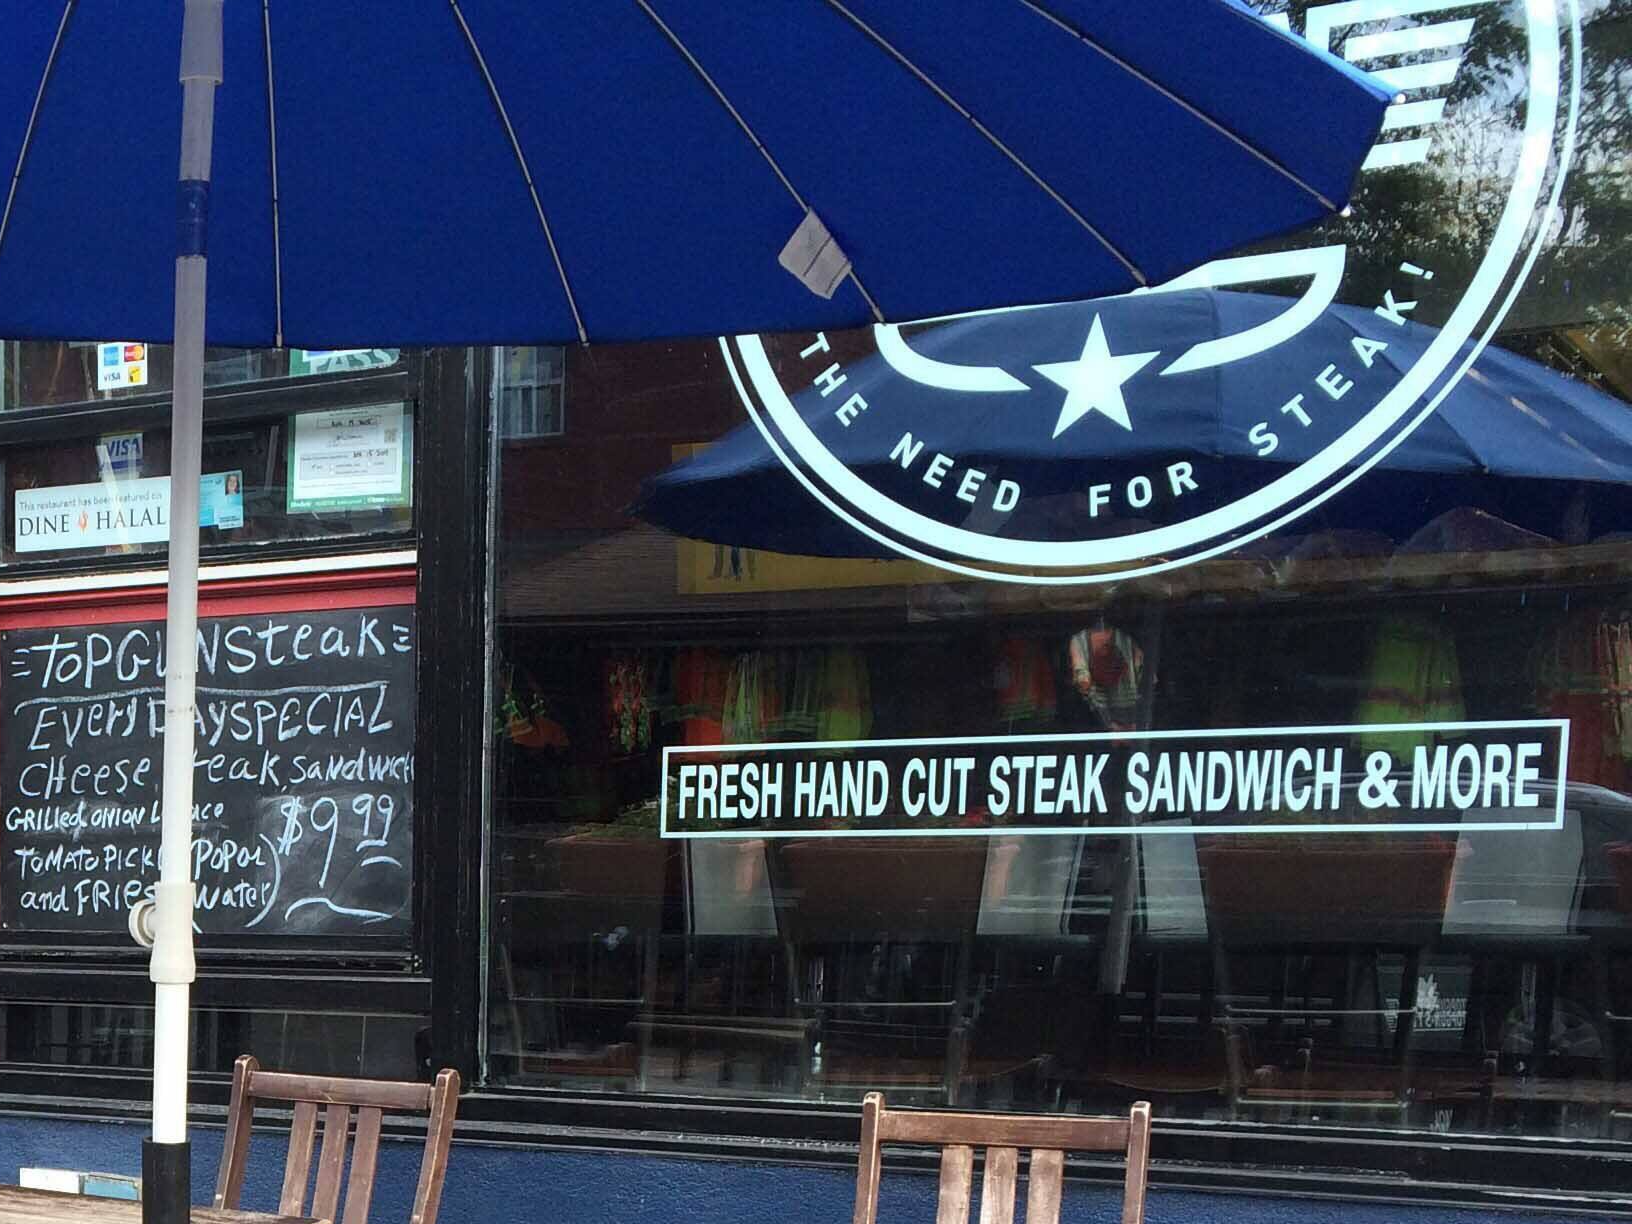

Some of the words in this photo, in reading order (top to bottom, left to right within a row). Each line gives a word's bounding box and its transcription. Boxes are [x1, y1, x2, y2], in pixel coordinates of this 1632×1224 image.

[103, 371, 121, 383] VISA
[800, 331, 868, 427] THE
[890, 431, 1020, 512] NEED
[1089, 461, 1199, 517] FOR
[1250, 262, 1435, 456] STEAK!
[107, 438, 142, 458] VISA
[19, 513, 70, 537] DINE
[96, 506, 167, 531] HALAL
[678, 762, 783, 819] FRESH
[794, 760, 889, 817] HAND
[902, 757, 976, 817] CUT
[987, 753, 1110, 816] STEAK
[1125, 747, 1343, 814] SANDWICH
[1358, 750, 1402, 809] &
[1411, 742, 1542, 809] MORE
